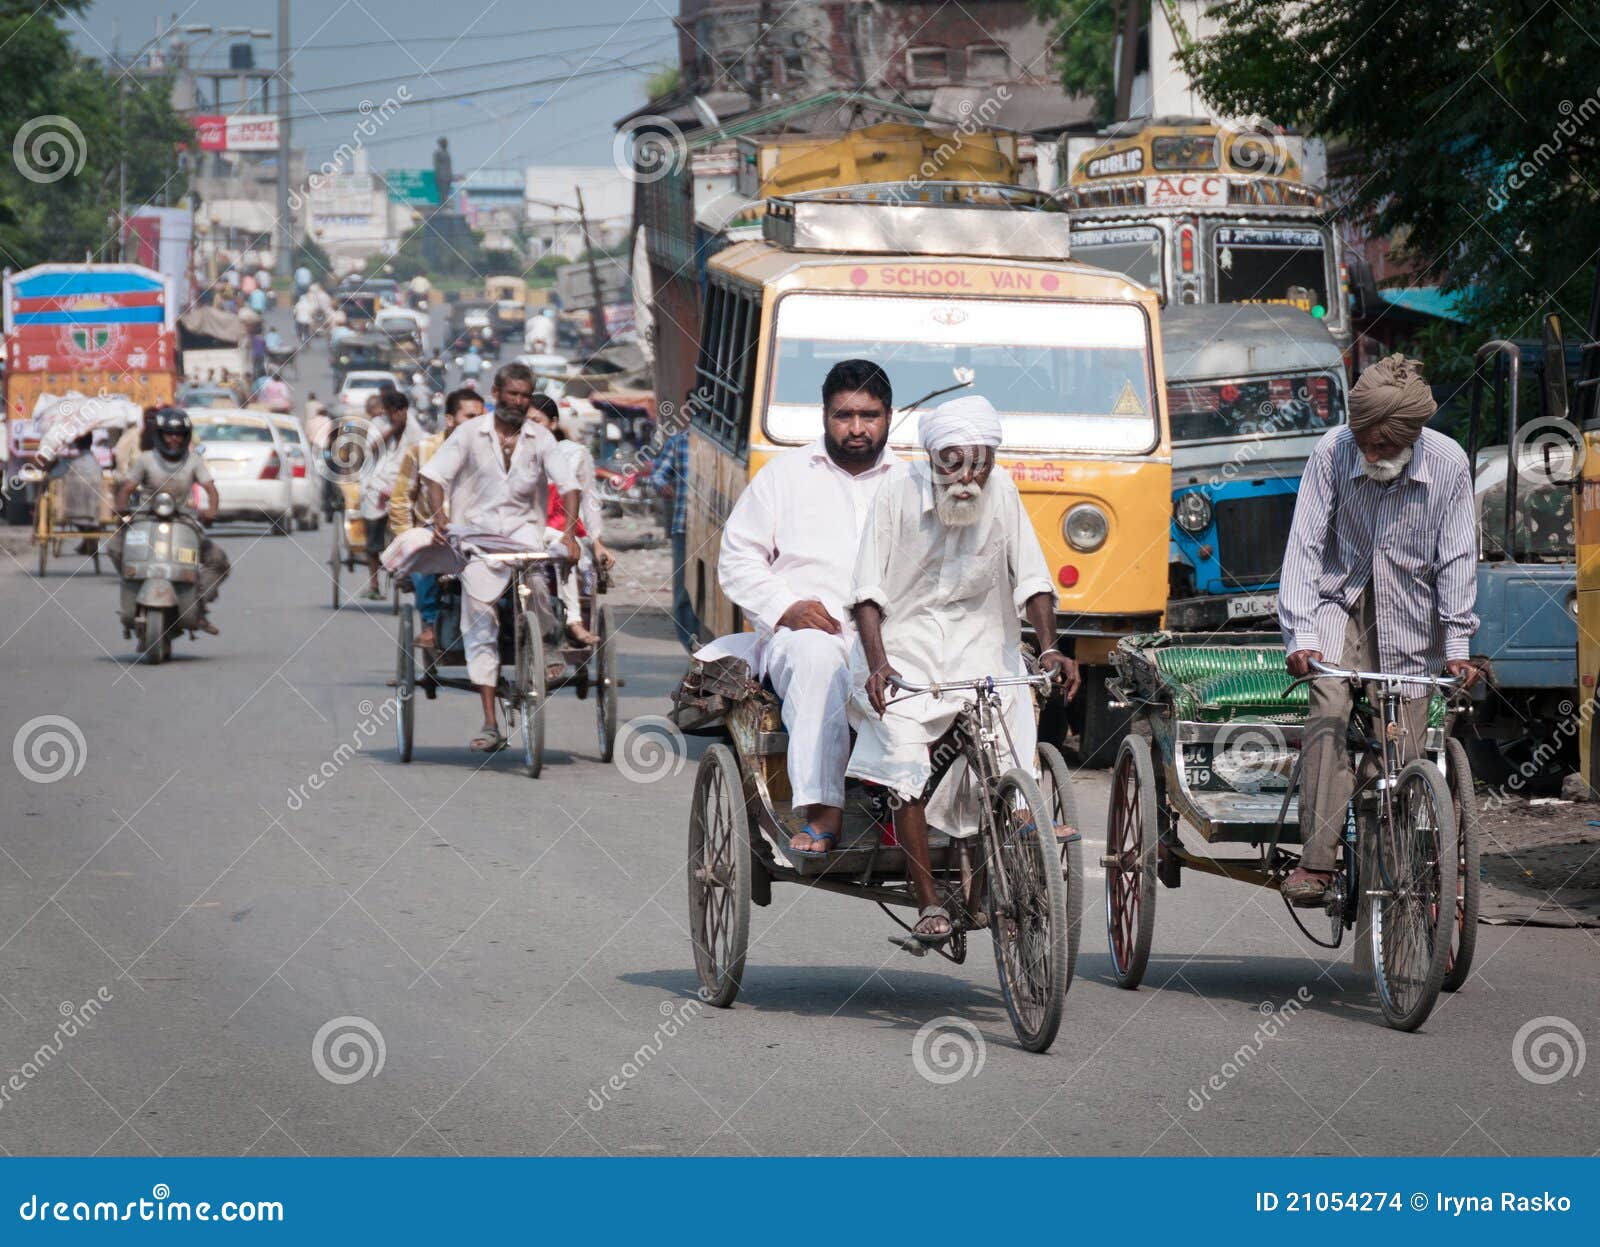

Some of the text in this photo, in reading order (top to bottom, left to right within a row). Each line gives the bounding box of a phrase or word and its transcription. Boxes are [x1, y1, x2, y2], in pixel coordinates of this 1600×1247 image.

[1088, 148, 1142, 178] PUBLIC
[1152, 177, 1221, 197] ACC
[880, 267, 1032, 289] SCHOOL VAN
[1234, 602, 1258, 614] PJC
